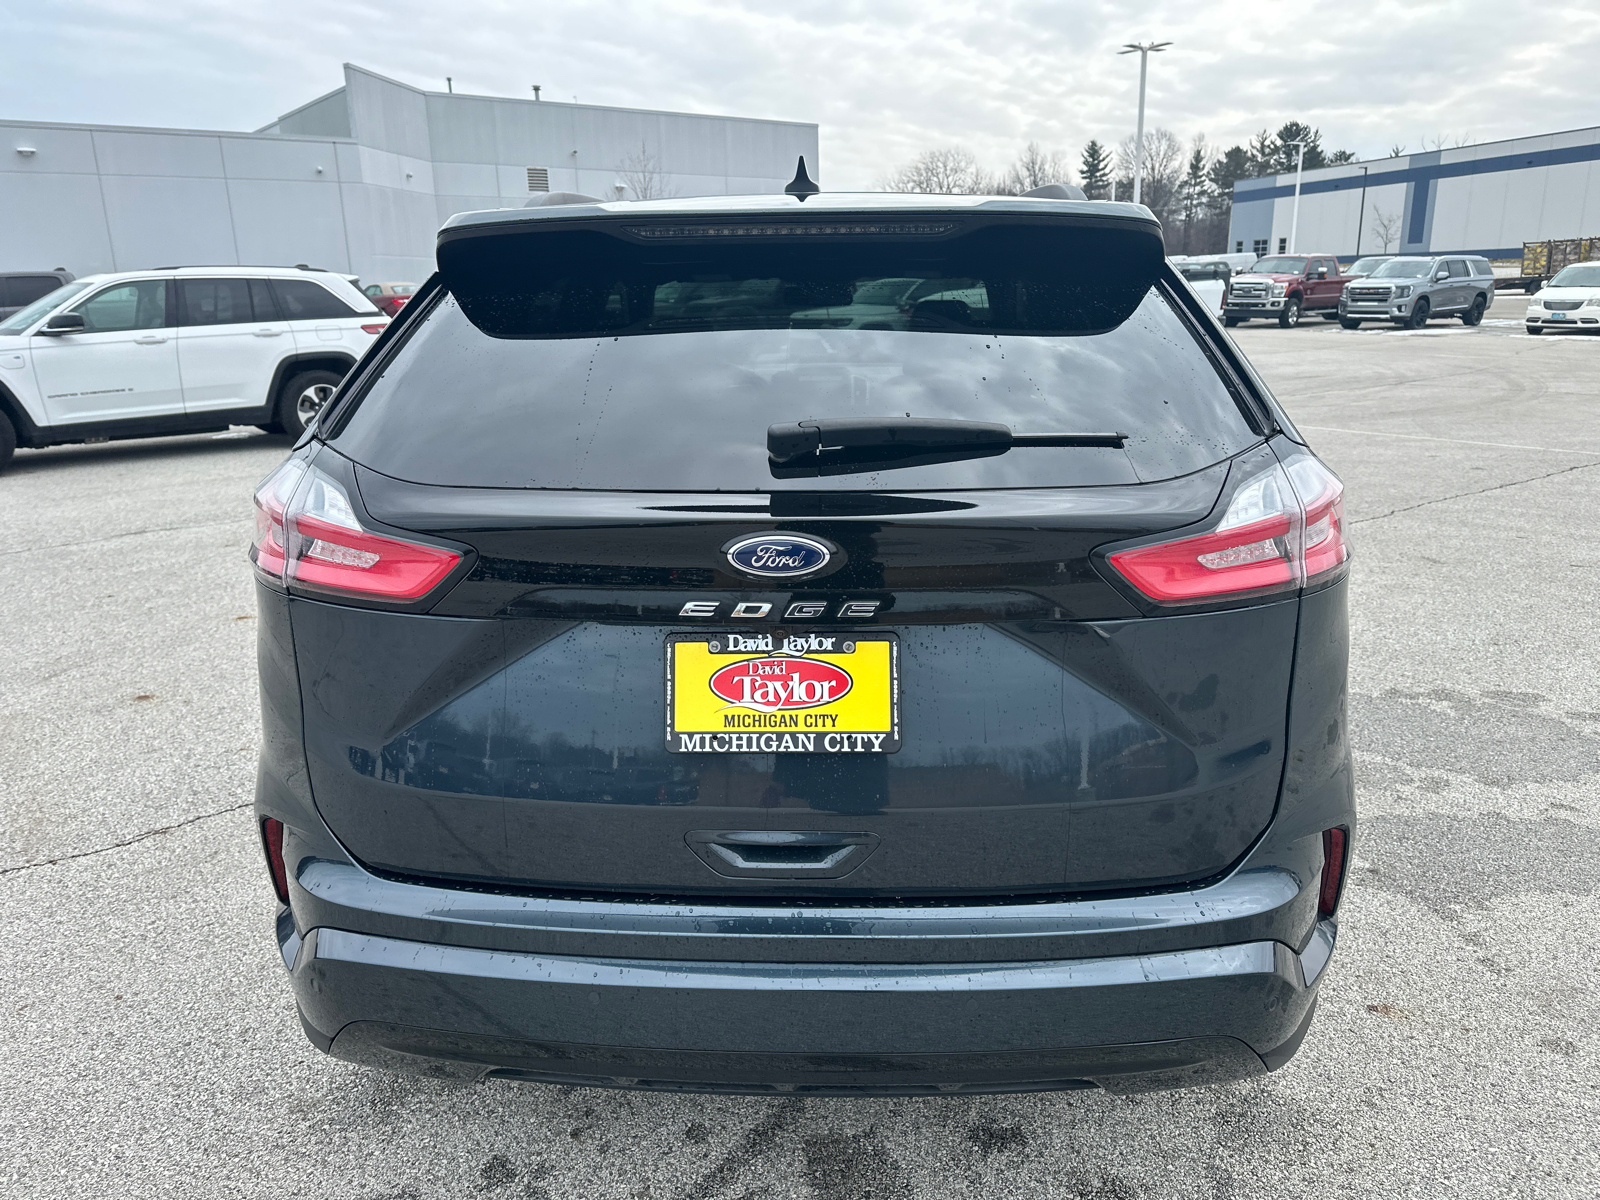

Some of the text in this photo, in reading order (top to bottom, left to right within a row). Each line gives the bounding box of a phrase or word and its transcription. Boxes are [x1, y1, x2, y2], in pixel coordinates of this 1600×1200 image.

[751, 545, 805, 568] Ford
[678, 601, 881, 618] EDGE
[727, 634, 773, 651] David
[747, 661, 786, 675] David
[722, 672, 836, 713] Taylor
[723, 714, 839, 728] MICHIGAN CITY
[679, 733, 887, 752] MICHIGAN CITY
